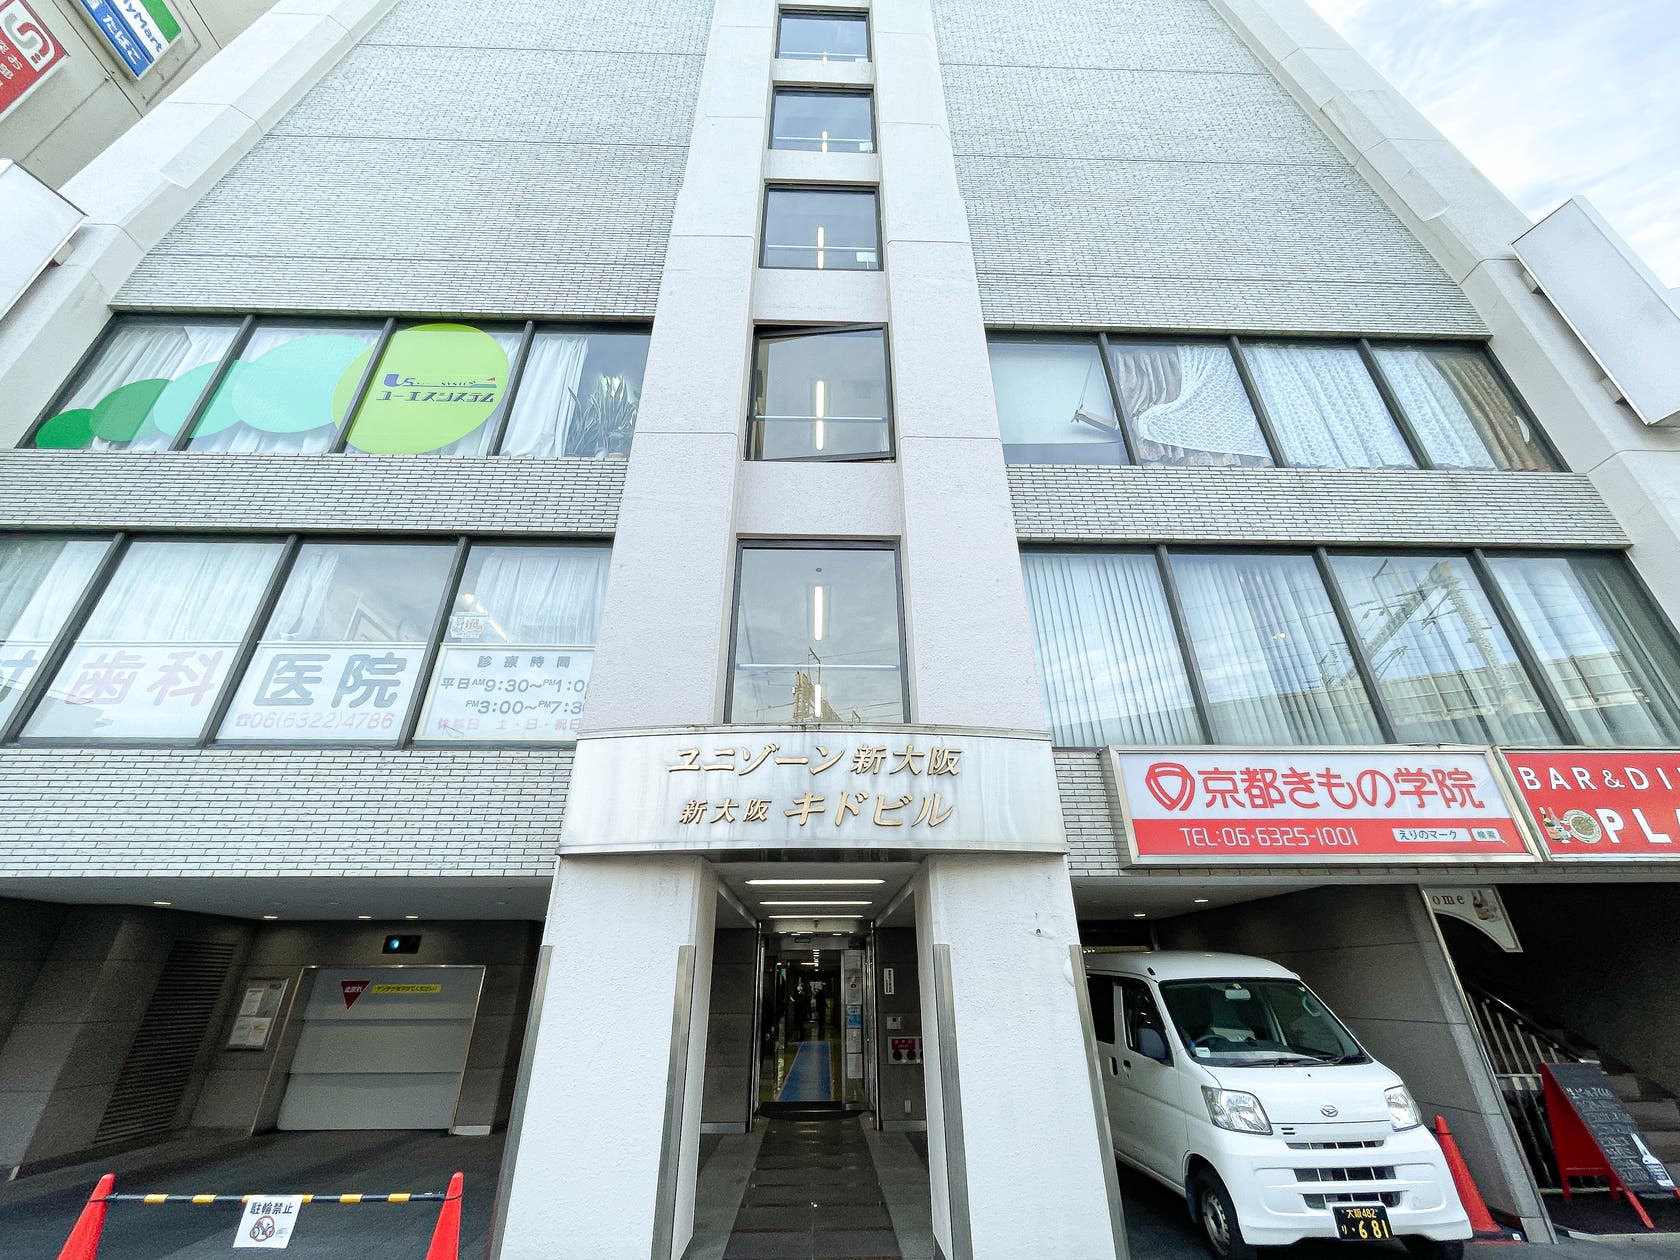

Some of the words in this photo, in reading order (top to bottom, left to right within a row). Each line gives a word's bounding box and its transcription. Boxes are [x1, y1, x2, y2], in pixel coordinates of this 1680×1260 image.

[1197, 766, 1486, 810] 京都きもの学院
[1399, 829, 1457, 841] えりのマーク
[249, 1201, 294, 1216] 駐輪禁止
